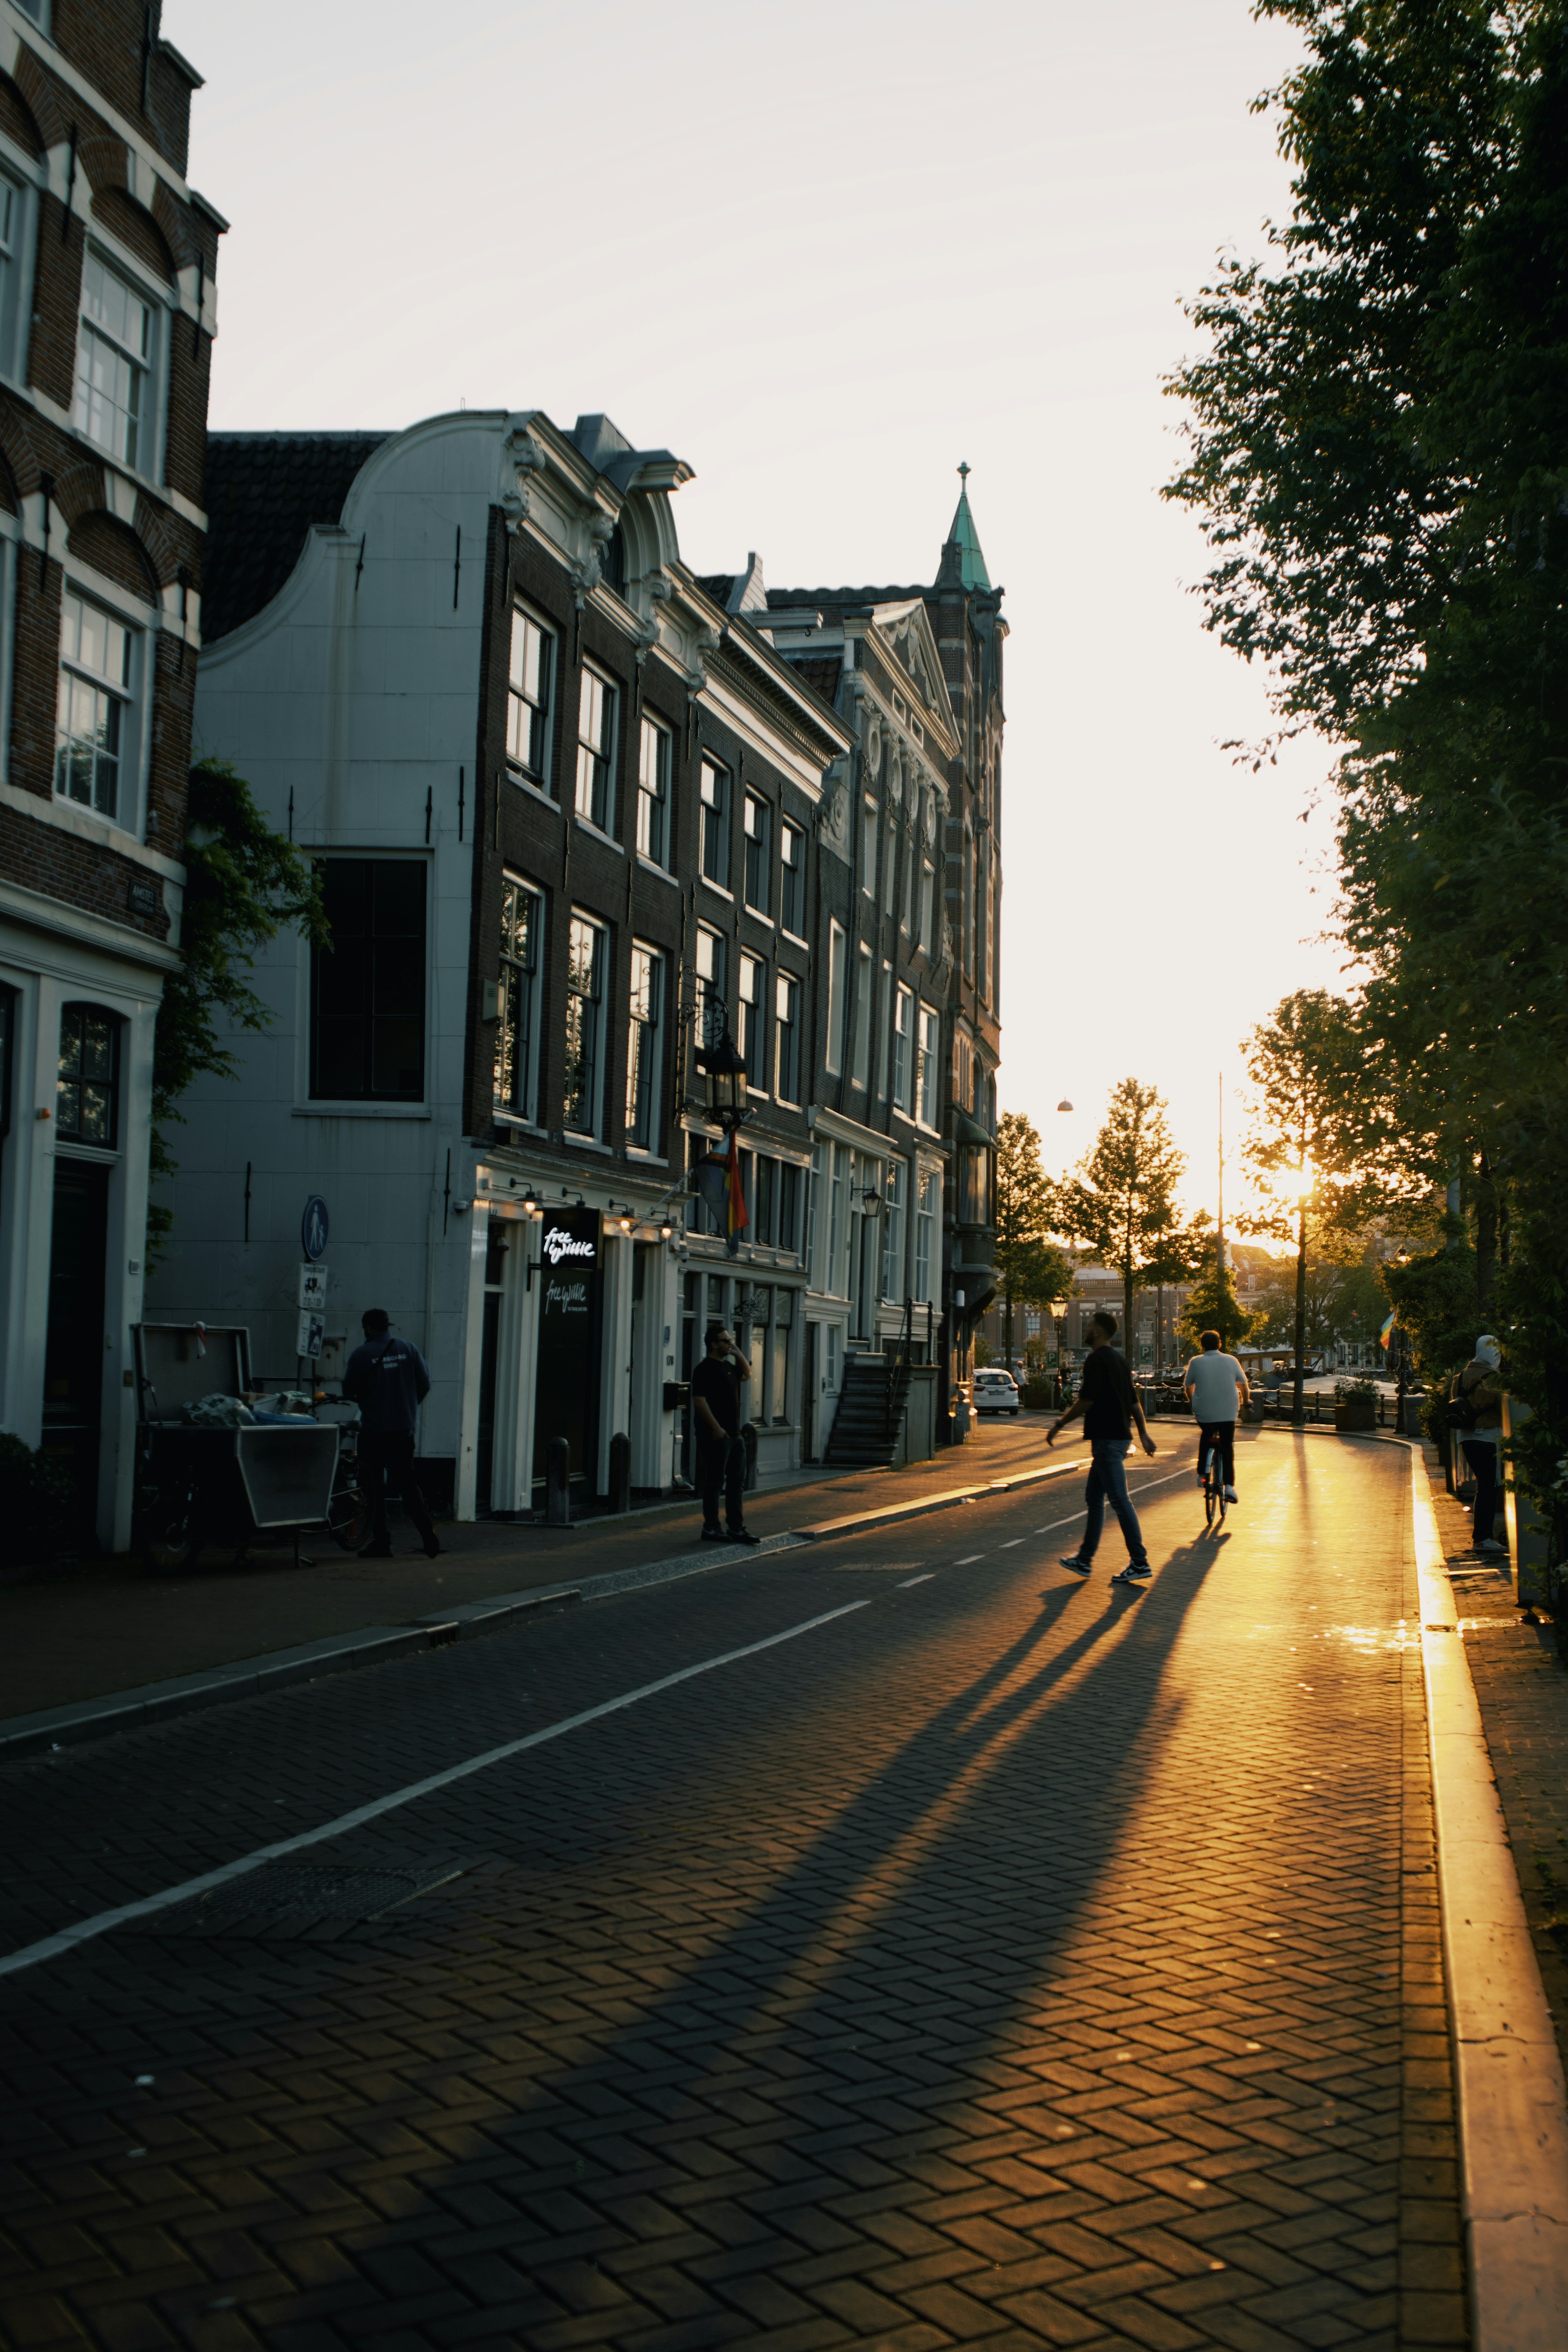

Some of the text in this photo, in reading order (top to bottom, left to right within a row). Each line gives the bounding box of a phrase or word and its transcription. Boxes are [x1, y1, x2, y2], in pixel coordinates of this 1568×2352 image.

[132, 885, 154, 904] AMSTEL
[544, 1227, 573, 1253] free
[1049, 1353, 1055, 1362] P
[1142, 1347, 1149, 1357] P
